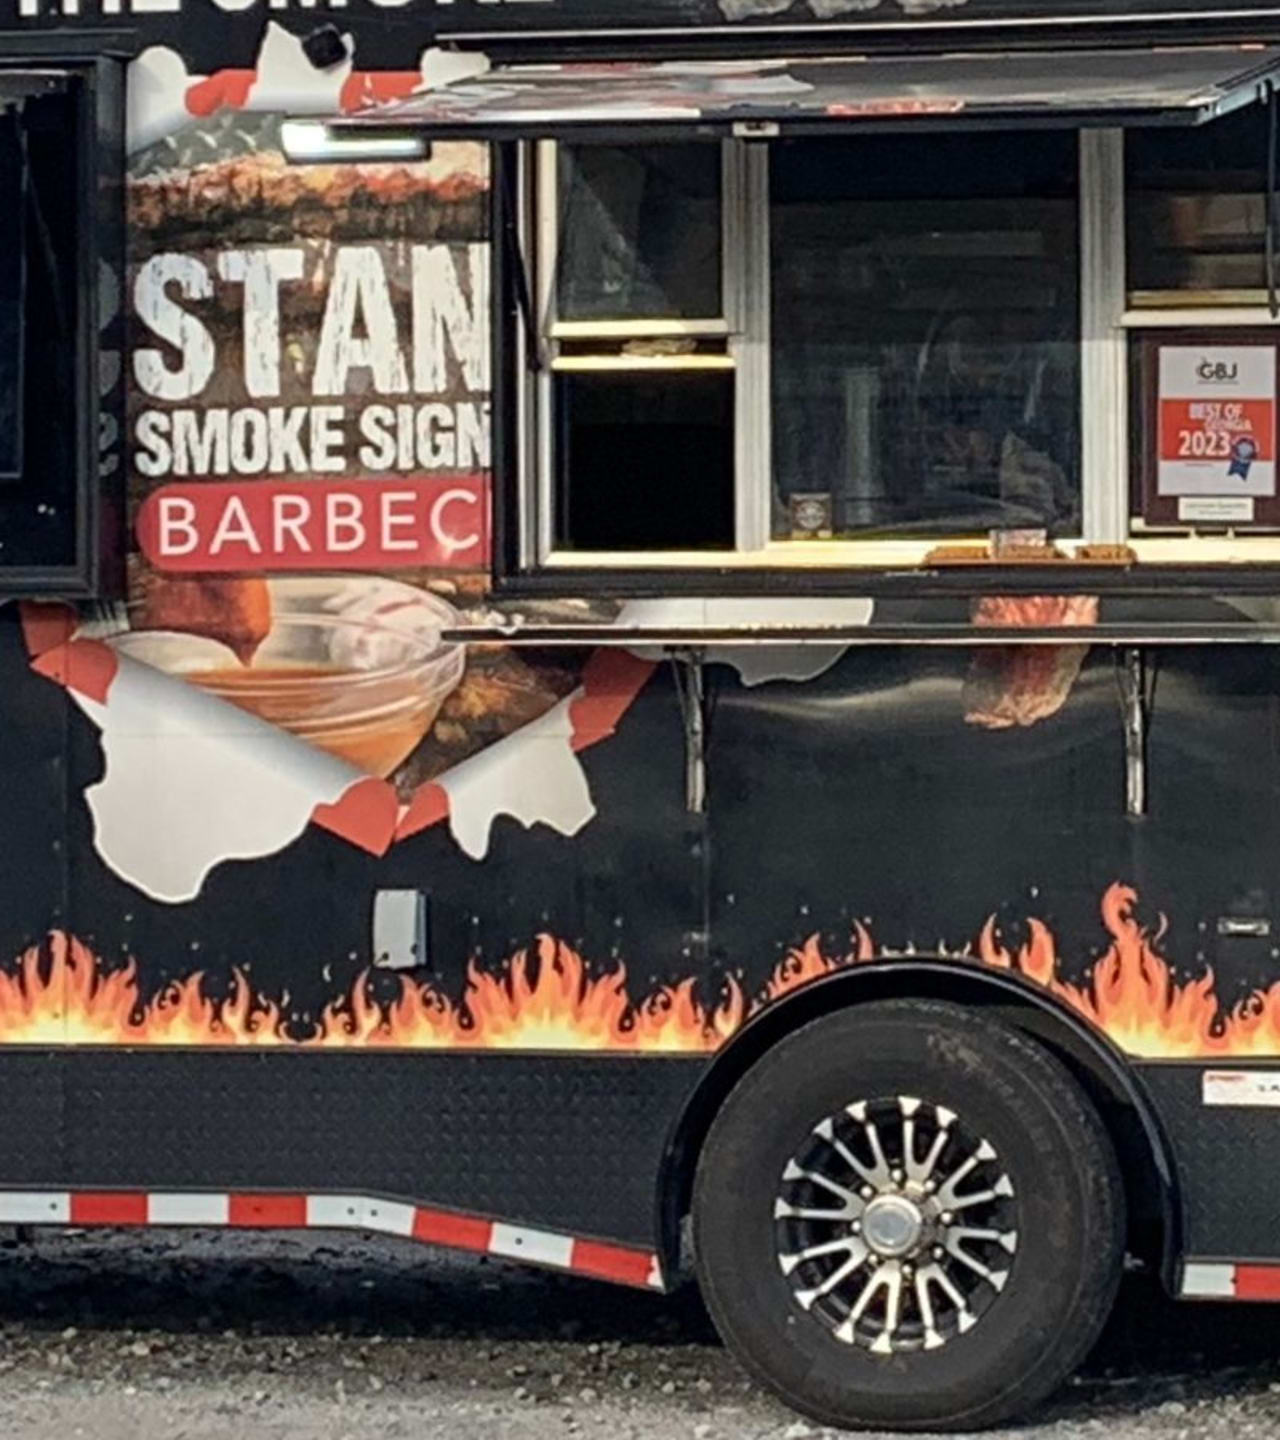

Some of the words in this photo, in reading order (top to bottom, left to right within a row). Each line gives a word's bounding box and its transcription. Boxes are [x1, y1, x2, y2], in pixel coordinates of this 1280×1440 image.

[132, 243, 491, 401] STAN
[1195, 361, 1238, 380] GBJ
[1189, 402, 1221, 420] BEST
[1224, 403, 1244, 420] OF
[133, 406, 346, 477] SMOKE
[359, 403, 491, 471] SIGN
[1178, 430, 1232, 457] 2023
[158, 488, 480, 557] BARBEC
